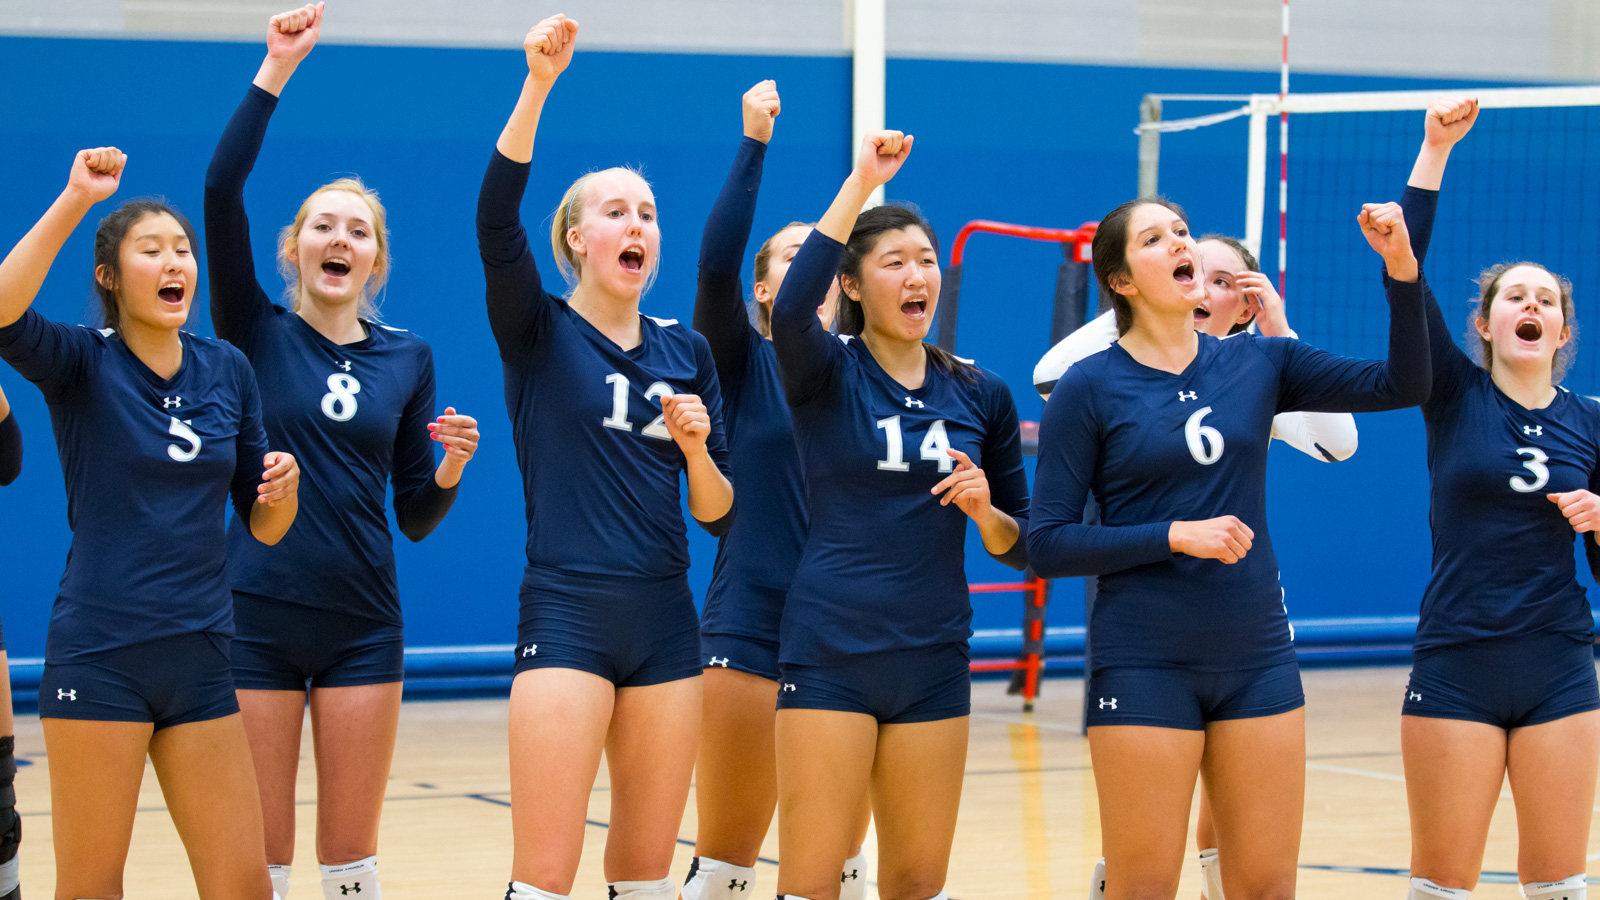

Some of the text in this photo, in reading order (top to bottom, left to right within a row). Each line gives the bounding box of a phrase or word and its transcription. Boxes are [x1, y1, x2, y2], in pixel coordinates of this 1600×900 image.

[320, 372, 361, 422] 8
[602, 372, 675, 442] 12
[167, 416, 202, 463] 5
[876, 415, 956, 473] 14
[1184, 406, 1225, 466] 6
[1509, 446, 1550, 493] 3
